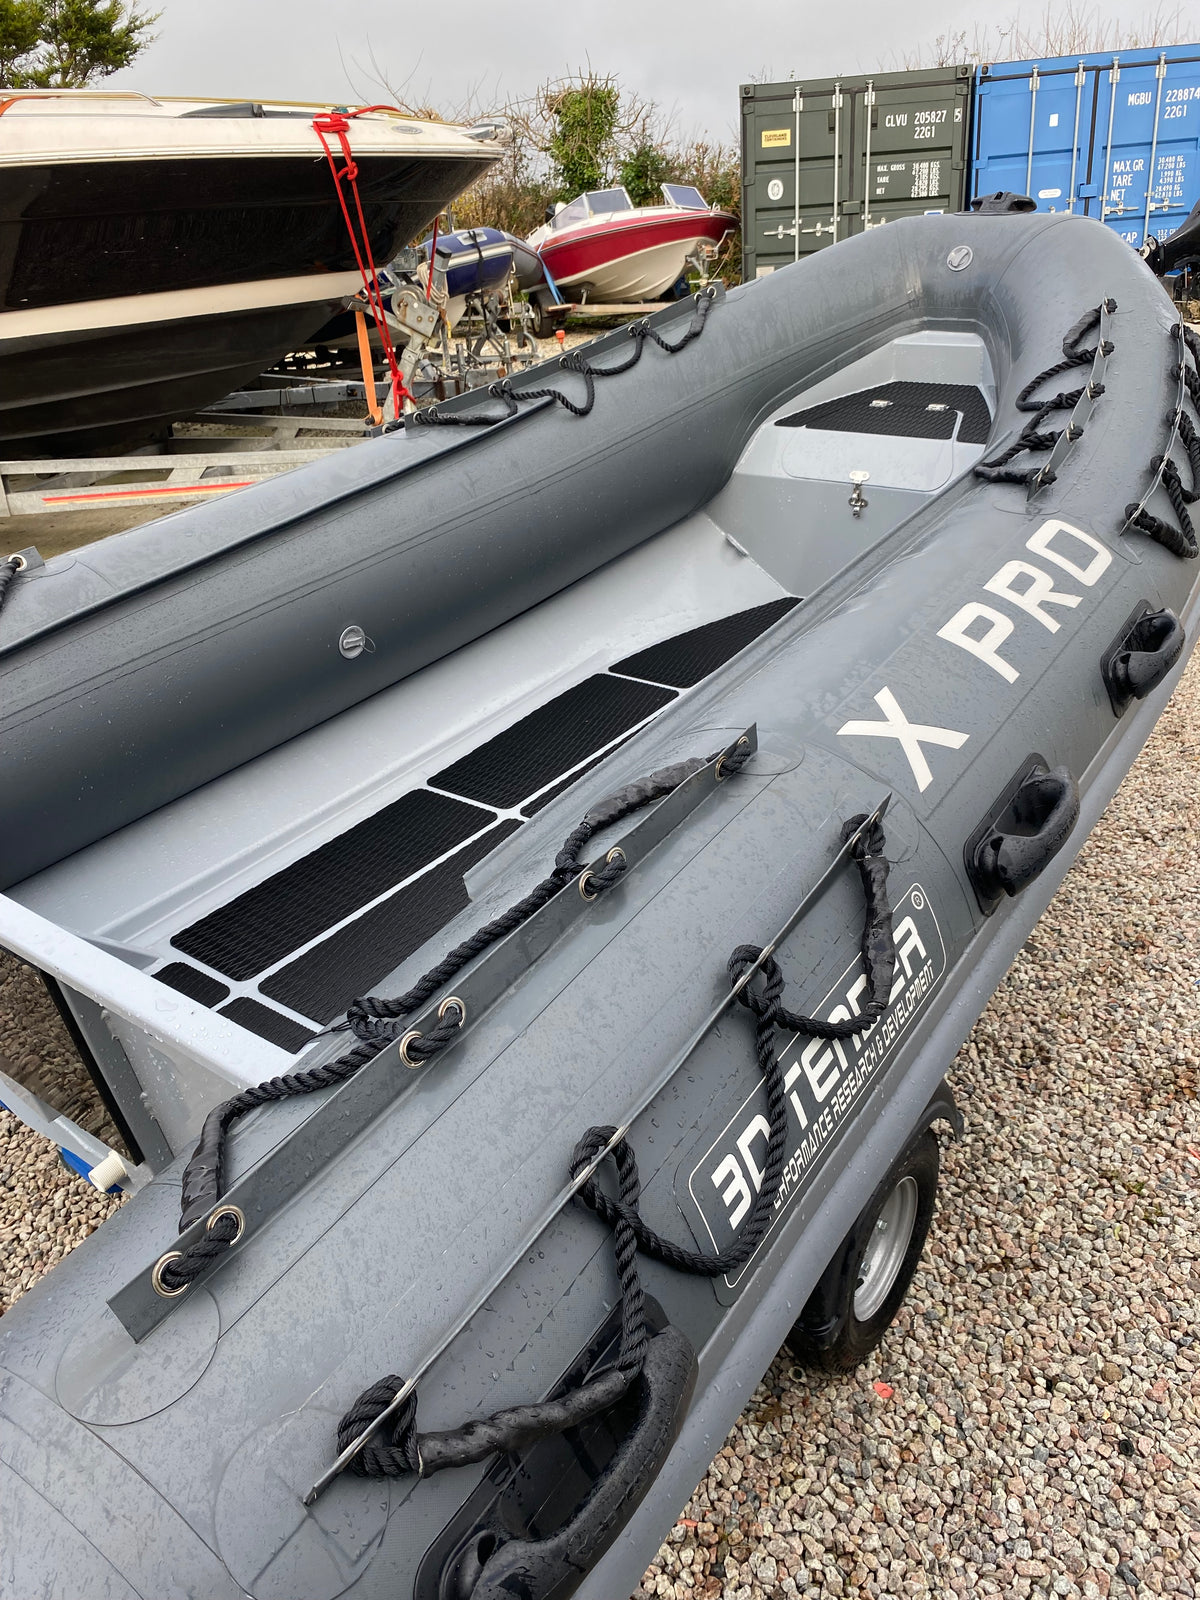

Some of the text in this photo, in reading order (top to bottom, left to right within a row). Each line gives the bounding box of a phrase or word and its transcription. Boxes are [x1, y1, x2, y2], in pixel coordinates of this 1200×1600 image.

[1127, 87, 1200, 106] MGBU 228874
[885, 107, 962, 127] CLVU 205827 5
[1164, 104, 1187, 119] 22G1
[914, 125, 935, 139] 22G1
[1112, 174, 1134, 187] TARE
[1110, 189, 1126, 201] NET
[836, 519, 1113, 793] X PRO
[784, 916, 927, 1130] TENR
[769, 1106, 834, 1219] RFORMANCE
[830, 1042, 878, 1121] RESEARCH
[881, 958, 935, 1047] DEVELOPMENT
